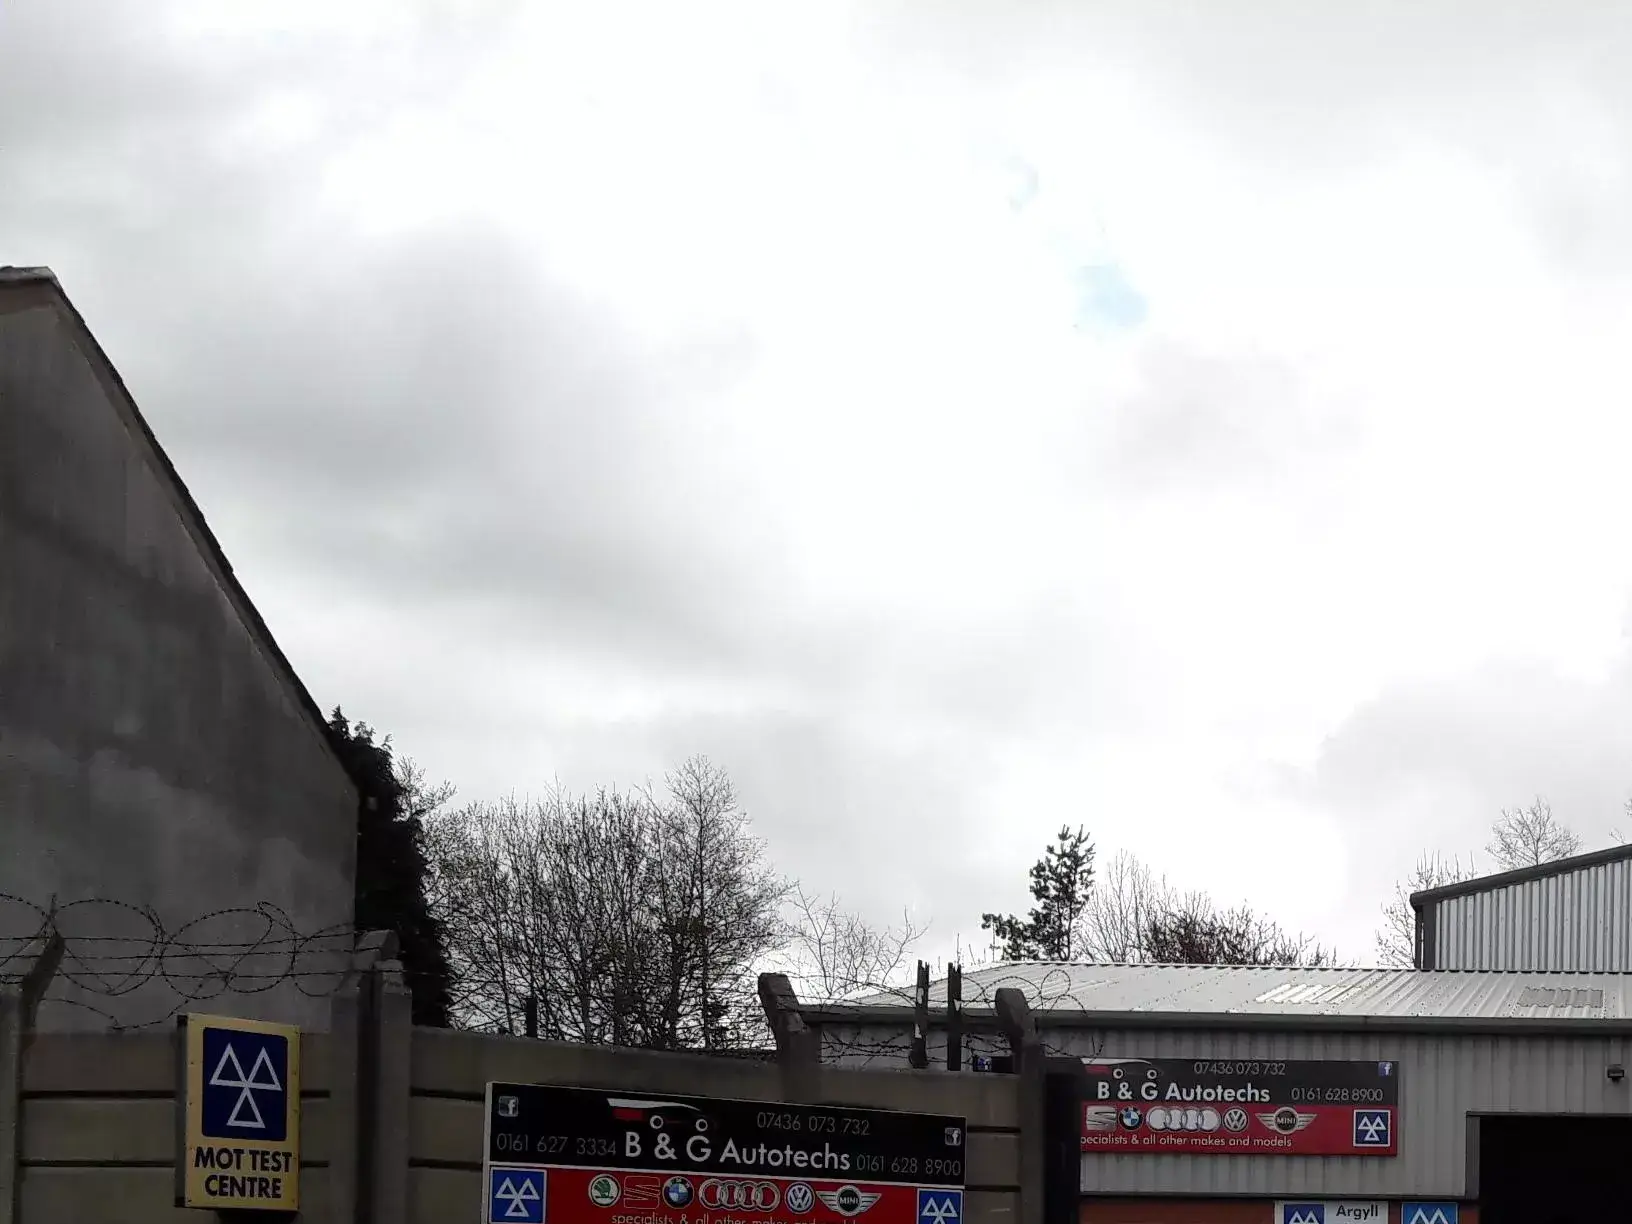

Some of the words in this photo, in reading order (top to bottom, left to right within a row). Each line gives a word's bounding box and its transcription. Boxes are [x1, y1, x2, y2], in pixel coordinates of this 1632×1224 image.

[1194, 1062, 1234, 1075] 07436
[1236, 1062, 1260, 1075] 073
[1262, 1062, 1286, 1076] 732
[1096, 1081, 1111, 1100] B
[1117, 1081, 1133, 1100] &
[1140, 1081, 1159, 1101] G
[1165, 1081, 1271, 1103] Autotechs
[1290, 1087, 1321, 1100] 0161
[1325, 1088, 1350, 1101] 628
[1351, 1088, 1384, 1101] 8900
[757, 1111, 801, 1131] 07436
[808, 1115, 836, 1133] 073
[842, 1117, 871, 1136] 732
[1276, 1117, 1297, 1125] MINI
[496, 1132, 529, 1152] 0161
[536, 1135, 569, 1153] 627
[576, 1137, 617, 1156] 3334
[625, 1131, 642, 1158] B
[654, 1132, 678, 1160] &
[686, 1135, 712, 1162] G
[719, 1137, 851, 1171] Autotechs
[1080, 1132, 1128, 1148] pecialists
[1131, 1133, 1140, 1145] &
[1143, 1133, 1156, 1145] all
[1159, 1133, 1188, 1145] other
[1190, 1134, 1226, 1146] makes
[1229, 1136, 1250, 1147] and
[1253, 1136, 1293, 1147] models
[194, 1146, 245, 1171] MOT
[248, 1149, 293, 1173] TEST
[856, 1154, 885, 1172] 0161
[891, 1156, 918, 1174] 628
[925, 1158, 962, 1176] 8900
[204, 1174, 283, 1199] CENTRE
[838, 1195, 860, 1205] MINI
[1336, 1204, 1379, 1220] Argyll
